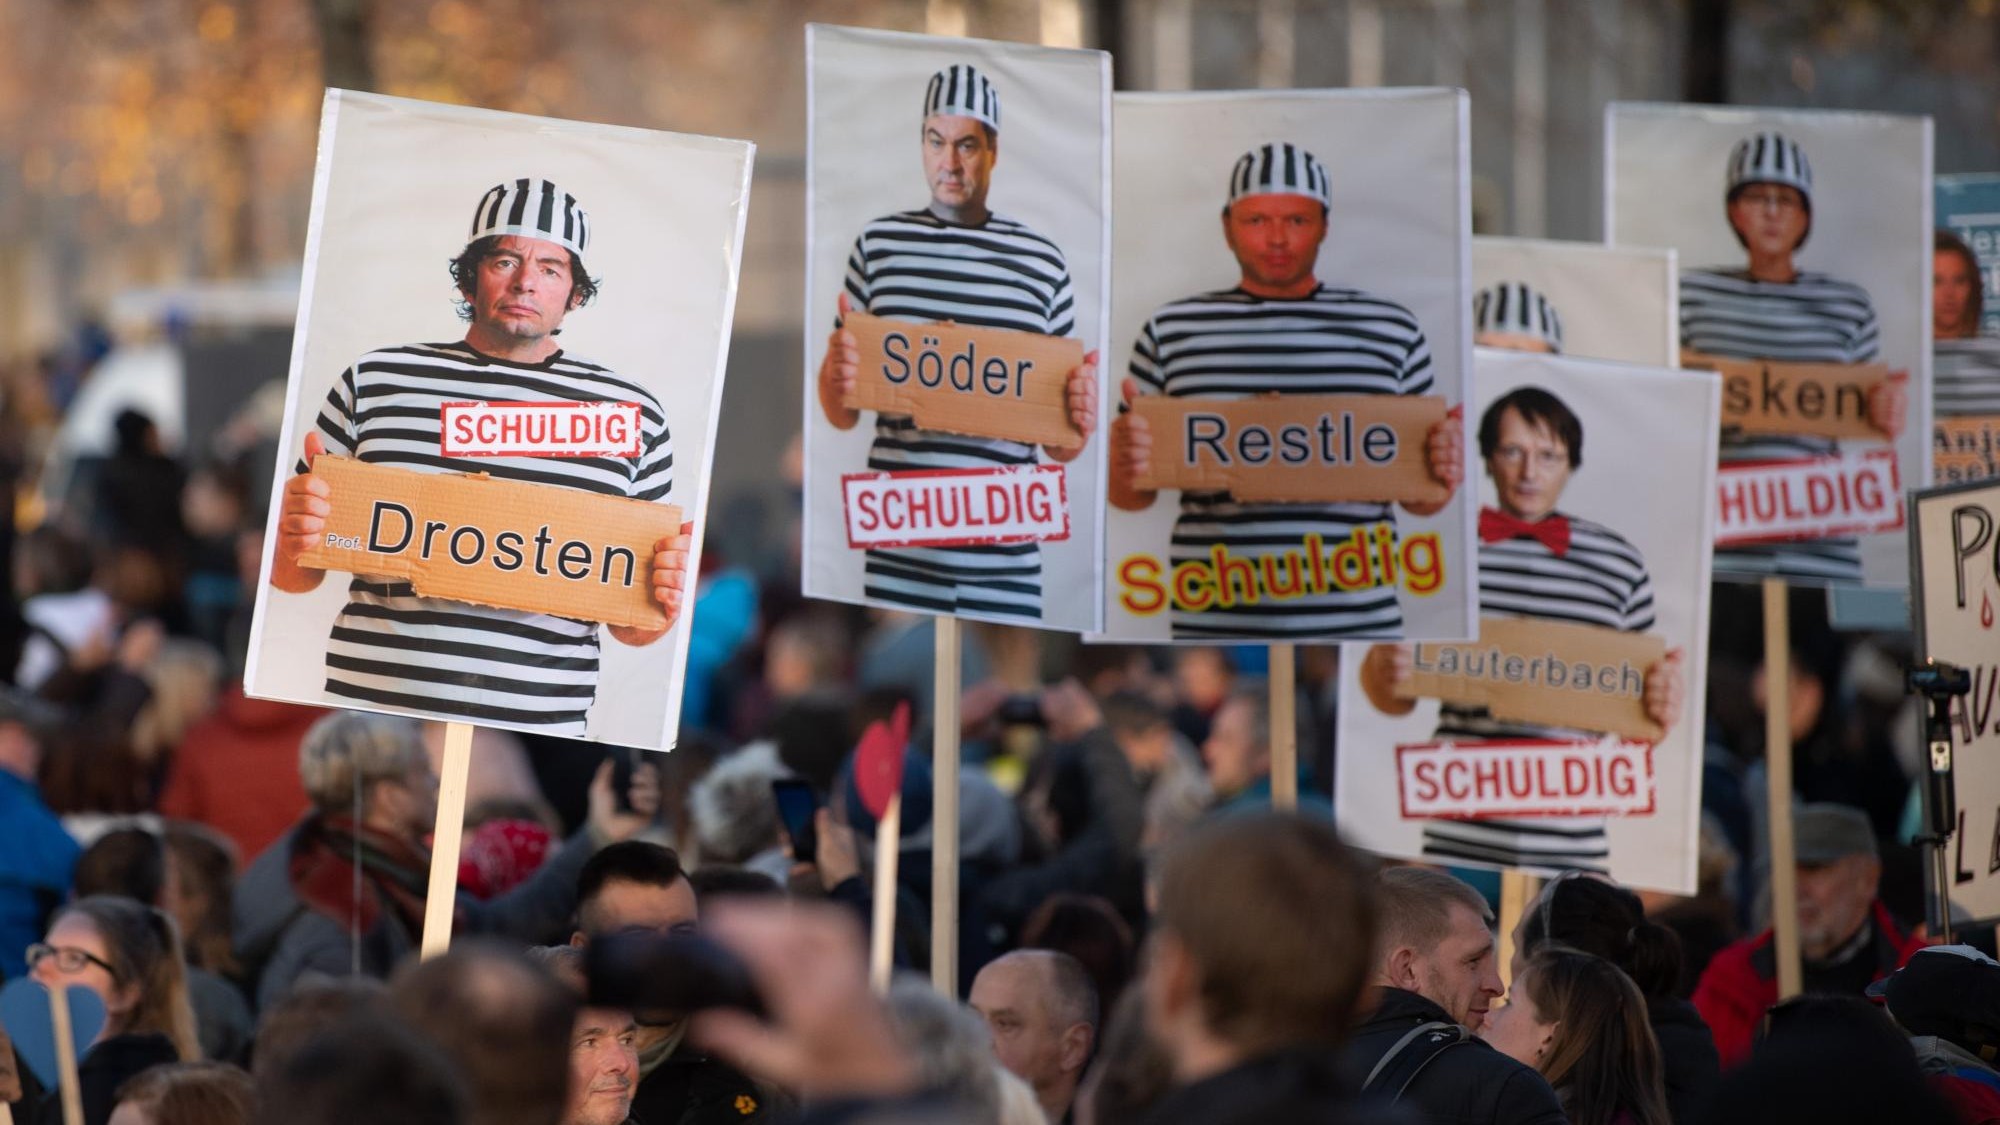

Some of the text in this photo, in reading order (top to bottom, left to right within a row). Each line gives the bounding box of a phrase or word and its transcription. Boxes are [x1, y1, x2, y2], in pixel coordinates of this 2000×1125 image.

[882, 332, 1033, 398] Söder
[1684, 362, 1868, 421] sken
[453, 413, 627, 445] SCHULDIG
[1186, 412, 1397, 464] Restle
[858, 482, 1052, 531] SCHULDIG
[1718, 470, 1884, 526] HULDIG
[326, 500, 636, 588] Prof. Drosten
[1117, 523, 1445, 616] Schuldig
[1951, 504, 2000, 609] P
[1413, 642, 1644, 694] Lauterbach
[1413, 756, 1637, 802] SCHULDIG
